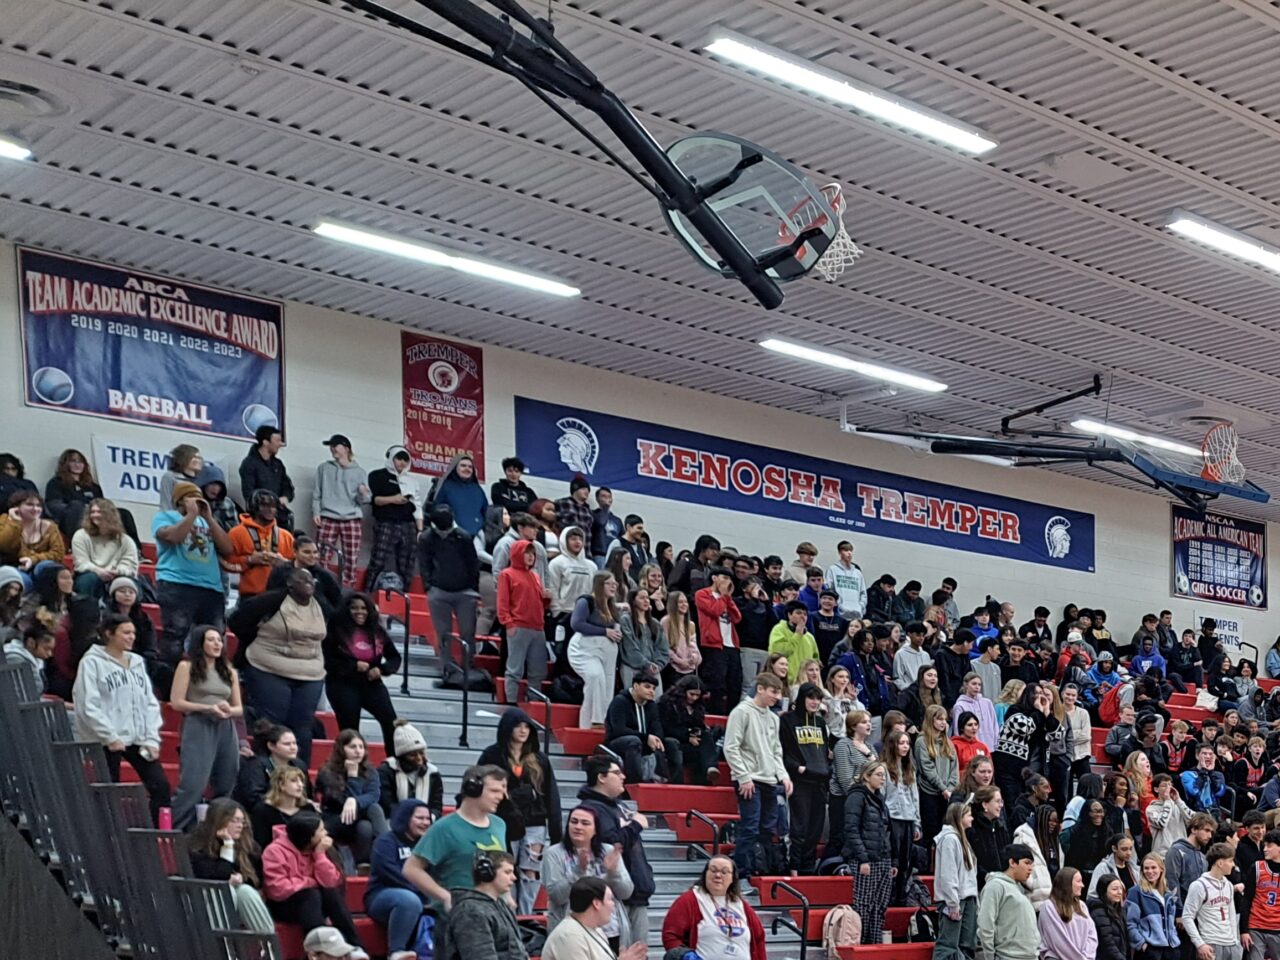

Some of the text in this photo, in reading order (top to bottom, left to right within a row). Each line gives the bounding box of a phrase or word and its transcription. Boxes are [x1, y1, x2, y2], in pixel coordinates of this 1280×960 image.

[124, 277, 190, 300] ABCA
[26, 270, 279, 359] TEAM ACADEMIC EXCELLENCE AWARD
[71, 314, 242, 358] 2019 2020 2021 2022 2023
[406, 343, 478, 379] TREMPER
[108, 389, 212, 425] BASEBALL
[410, 388, 478, 411] TROJANS
[107, 446, 171, 470] TREM
[636, 438, 1021, 544] KENOSHA TREMPER
[1205, 514, 1235, 527] NSCAA
[1174, 517, 1264, 558] ACADEMIC ALL AMERICAN TEAM
[1191, 581, 1214, 595] GIRLS
[1216, 585, 1247, 601] SOCCER
[1199, 616, 1238, 632] TMPER
[105, 670, 128, 692] NEW
[1266, 891, 1277, 907] 3
